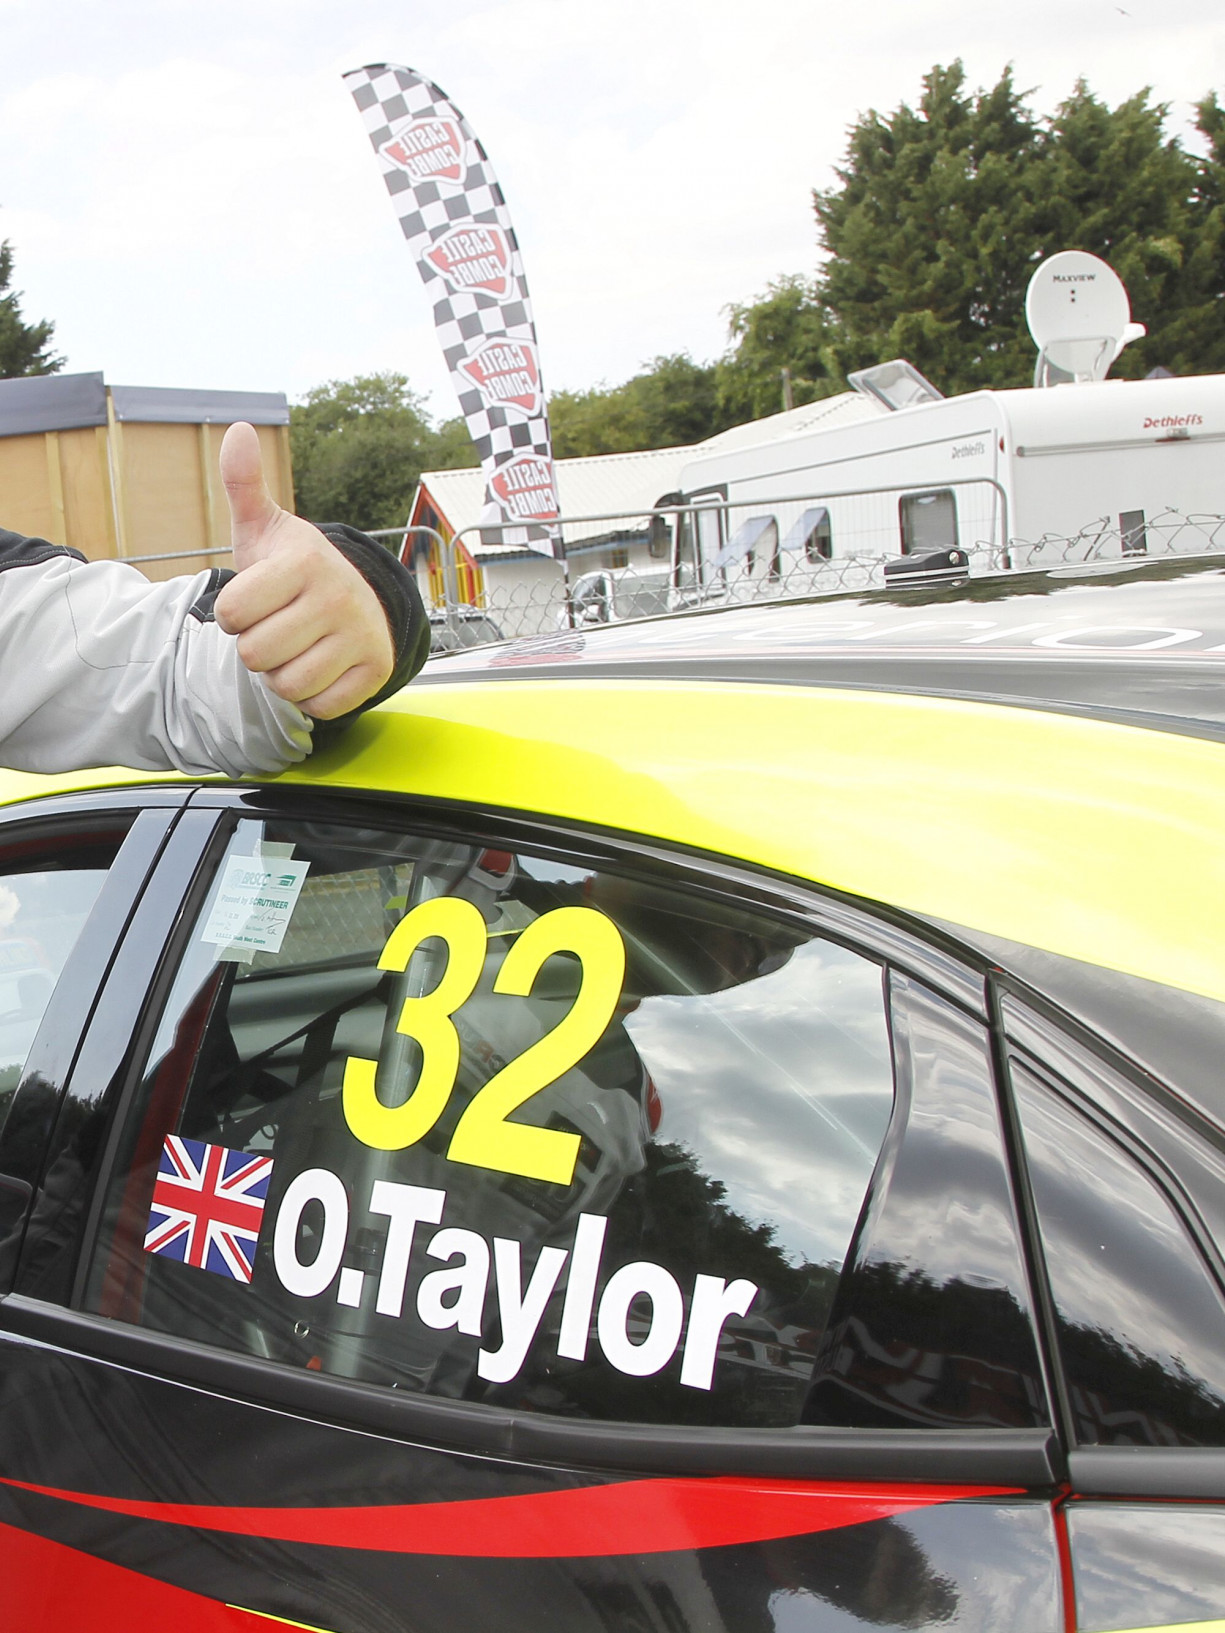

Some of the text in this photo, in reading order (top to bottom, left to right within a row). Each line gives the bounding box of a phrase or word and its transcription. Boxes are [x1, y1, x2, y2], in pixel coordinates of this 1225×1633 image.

[1142, 413, 1204, 429] Dethleffs
[249, 897, 289, 910] SCRUTINEER
[342, 896, 626, 1186] 32
[273, 1167, 760, 1391] O.Taylor
